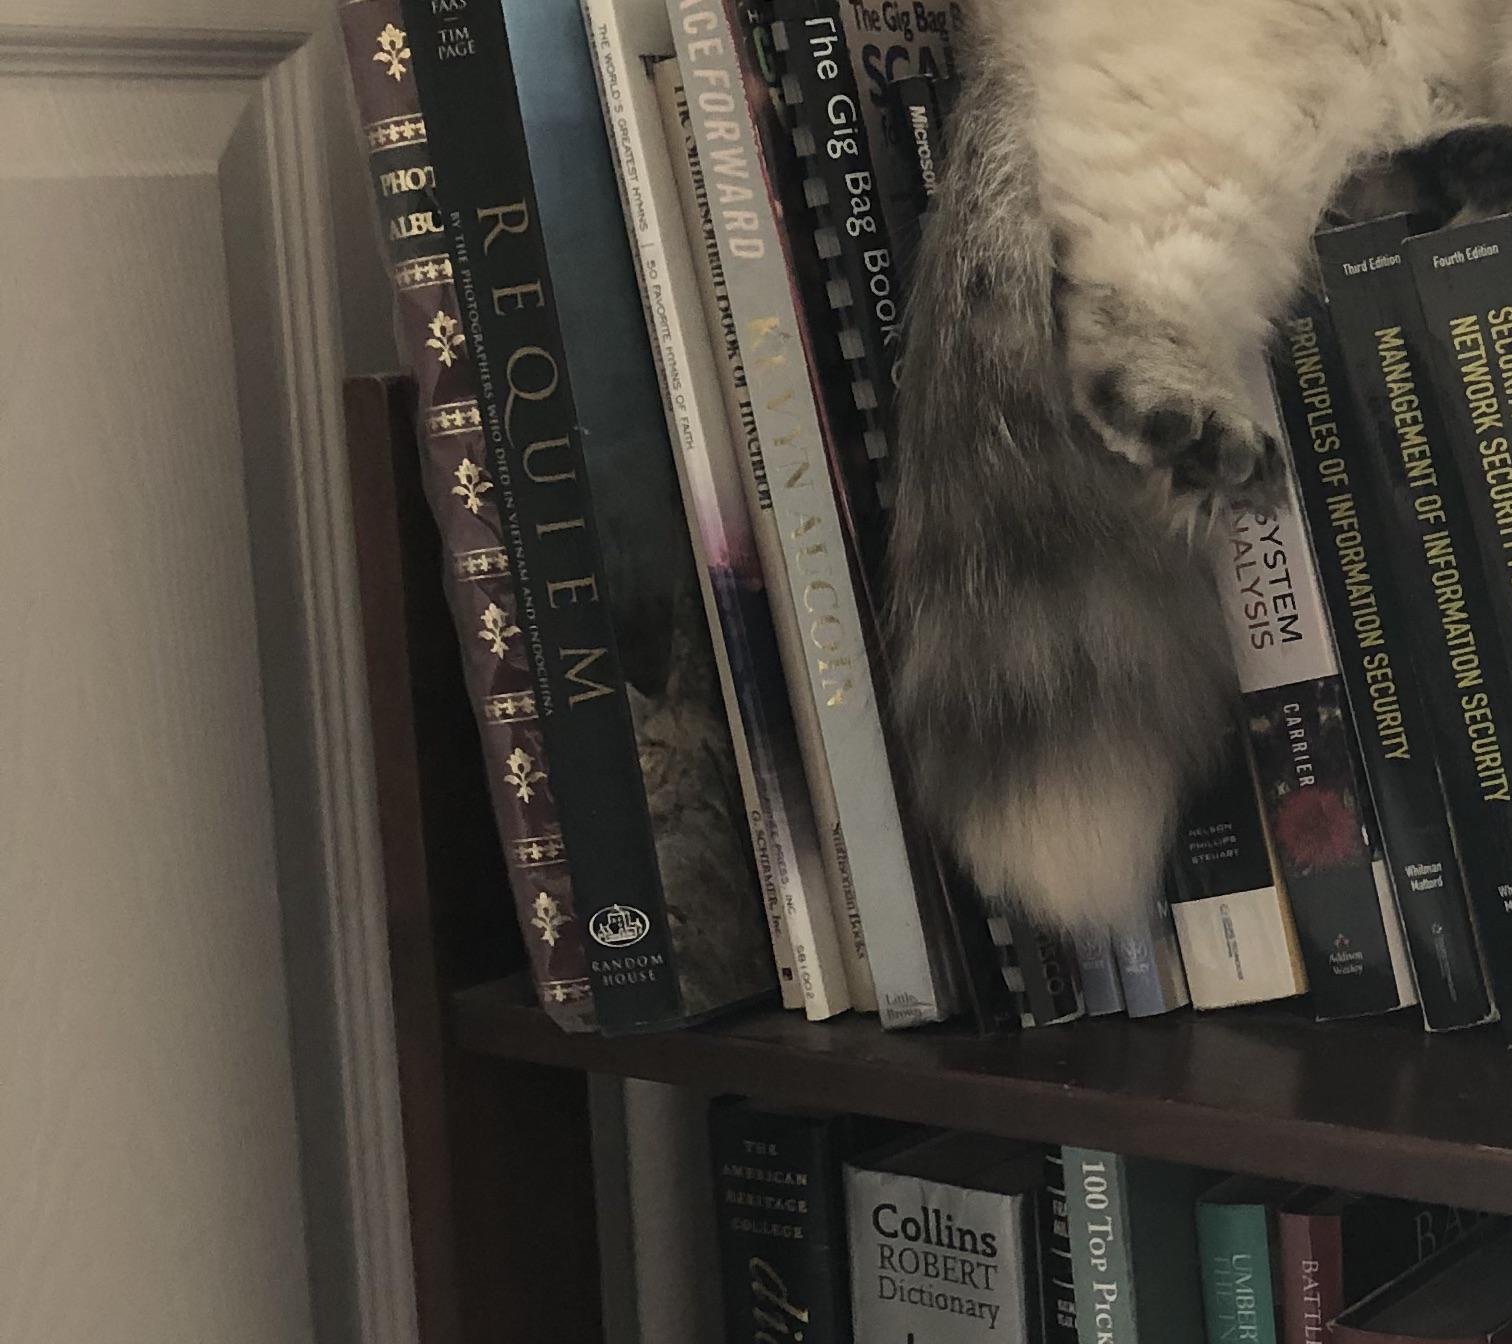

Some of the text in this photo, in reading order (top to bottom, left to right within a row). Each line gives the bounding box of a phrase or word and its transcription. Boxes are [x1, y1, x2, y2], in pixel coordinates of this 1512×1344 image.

[437, 27, 471, 44] TIM
[438, 39, 477, 59] PAGE
[803, 14, 846, 83] The
[882, 1, 914, 42] Gig
[596, 24, 649, 233] THE WORLD'S GREATEST HYMNS
[816, 92, 865, 160] Gig
[694, 79, 764, 259] FORWARD
[834, 168, 883, 240] Bag
[1343, 252, 1401, 277] Third Edition
[1433, 242, 1500, 269] Fourth Edition
[650, 283, 672, 343] FAVORITE
[862, 247, 909, 347] Book
[1449, 314, 1498, 435] NETWORK
[453, 234, 555, 717] THE PHOTOGRAPHERS WHO DIED VIETNAM AND INDOCHINA
[477, 197, 614, 711] REQUIEM
[1289, 316, 1411, 761] PRINCIPLES OF INFORMATION SECURITY
[1374, 325, 1511, 803] MANAGEMENT OF INFORMATION SECURITY
[1283, 702, 1316, 788] CARRIER
[1404, 861, 1443, 878] Whitman
[592, 953, 664, 974] RANDOM
[602, 967, 658, 985] HOUSE
[1079, 1159, 1109, 1213] 100
[871, 1203, 999, 1258] Collins
[877, 1242, 1000, 1292] ROBERT
[877, 1274, 1001, 1330] Dictionary
